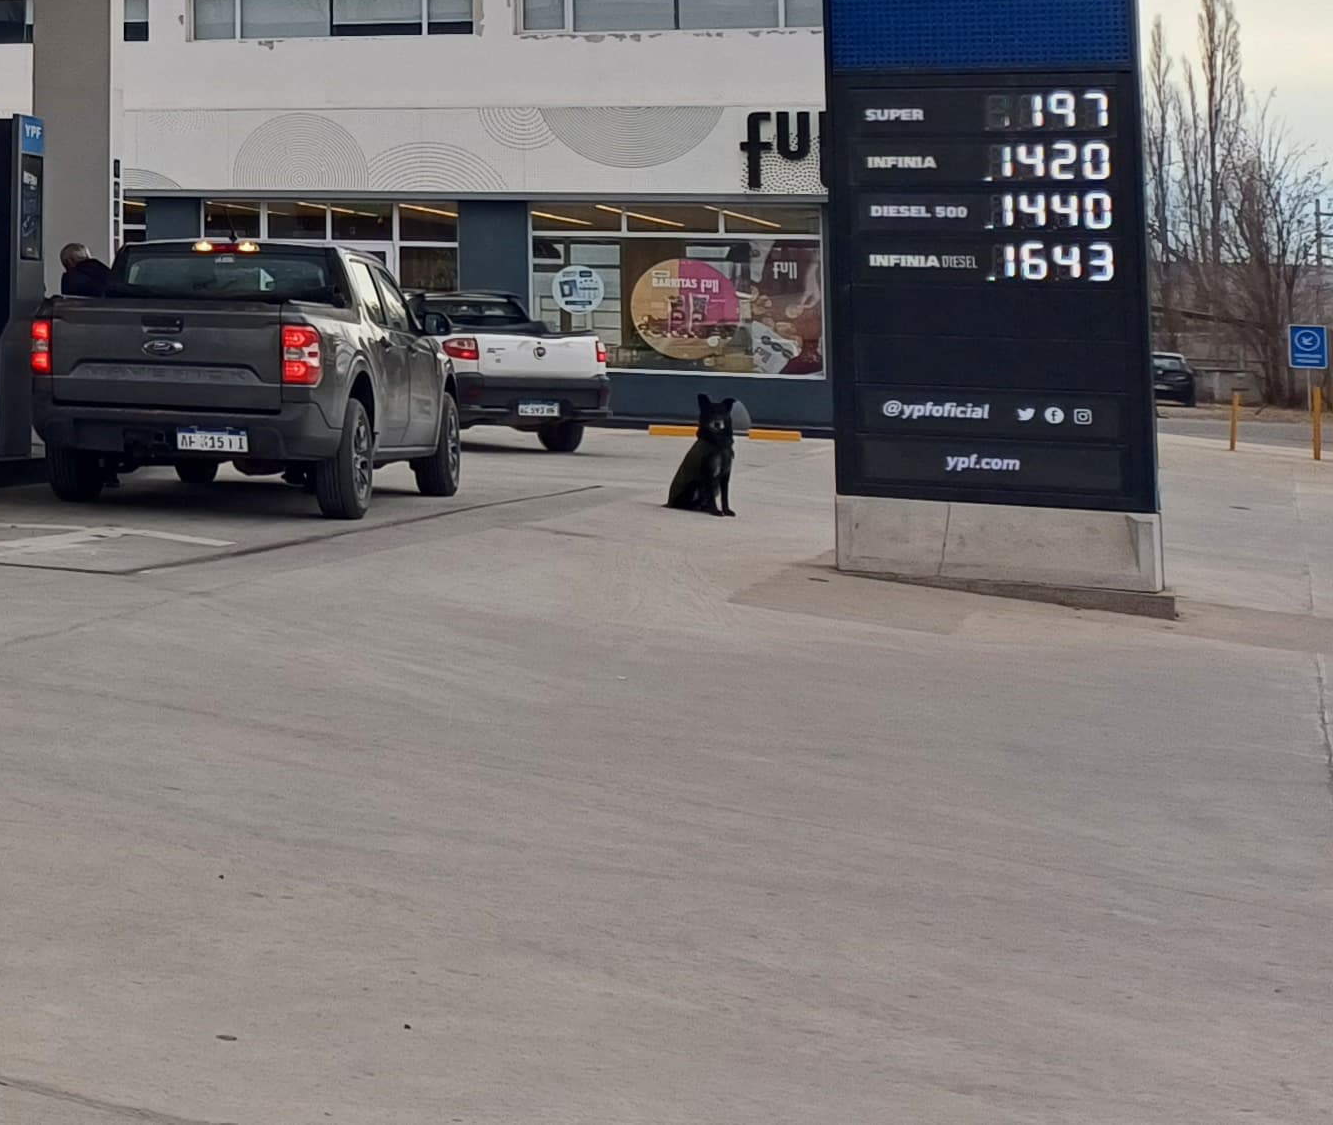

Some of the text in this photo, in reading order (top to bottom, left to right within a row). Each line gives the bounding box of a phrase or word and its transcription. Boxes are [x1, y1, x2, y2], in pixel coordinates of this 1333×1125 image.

[864, 108, 925, 122] SUPER
[24, 124, 42, 140] YPF
[866, 155, 938, 169] INFINIA
[1001, 140, 1112, 181] 1420
[870, 204, 968, 218] DIESEL 500
[1001, 192, 1113, 230] 1440
[773, 261, 798, 279] full
[869, 254, 978, 269] INFINIA DIESEL
[1004, 241, 1115, 282] 1643
[700, 279, 719, 293] full
[883, 399, 990, 420] @ypfoficial
[945, 453, 1021, 472] ypf.com
